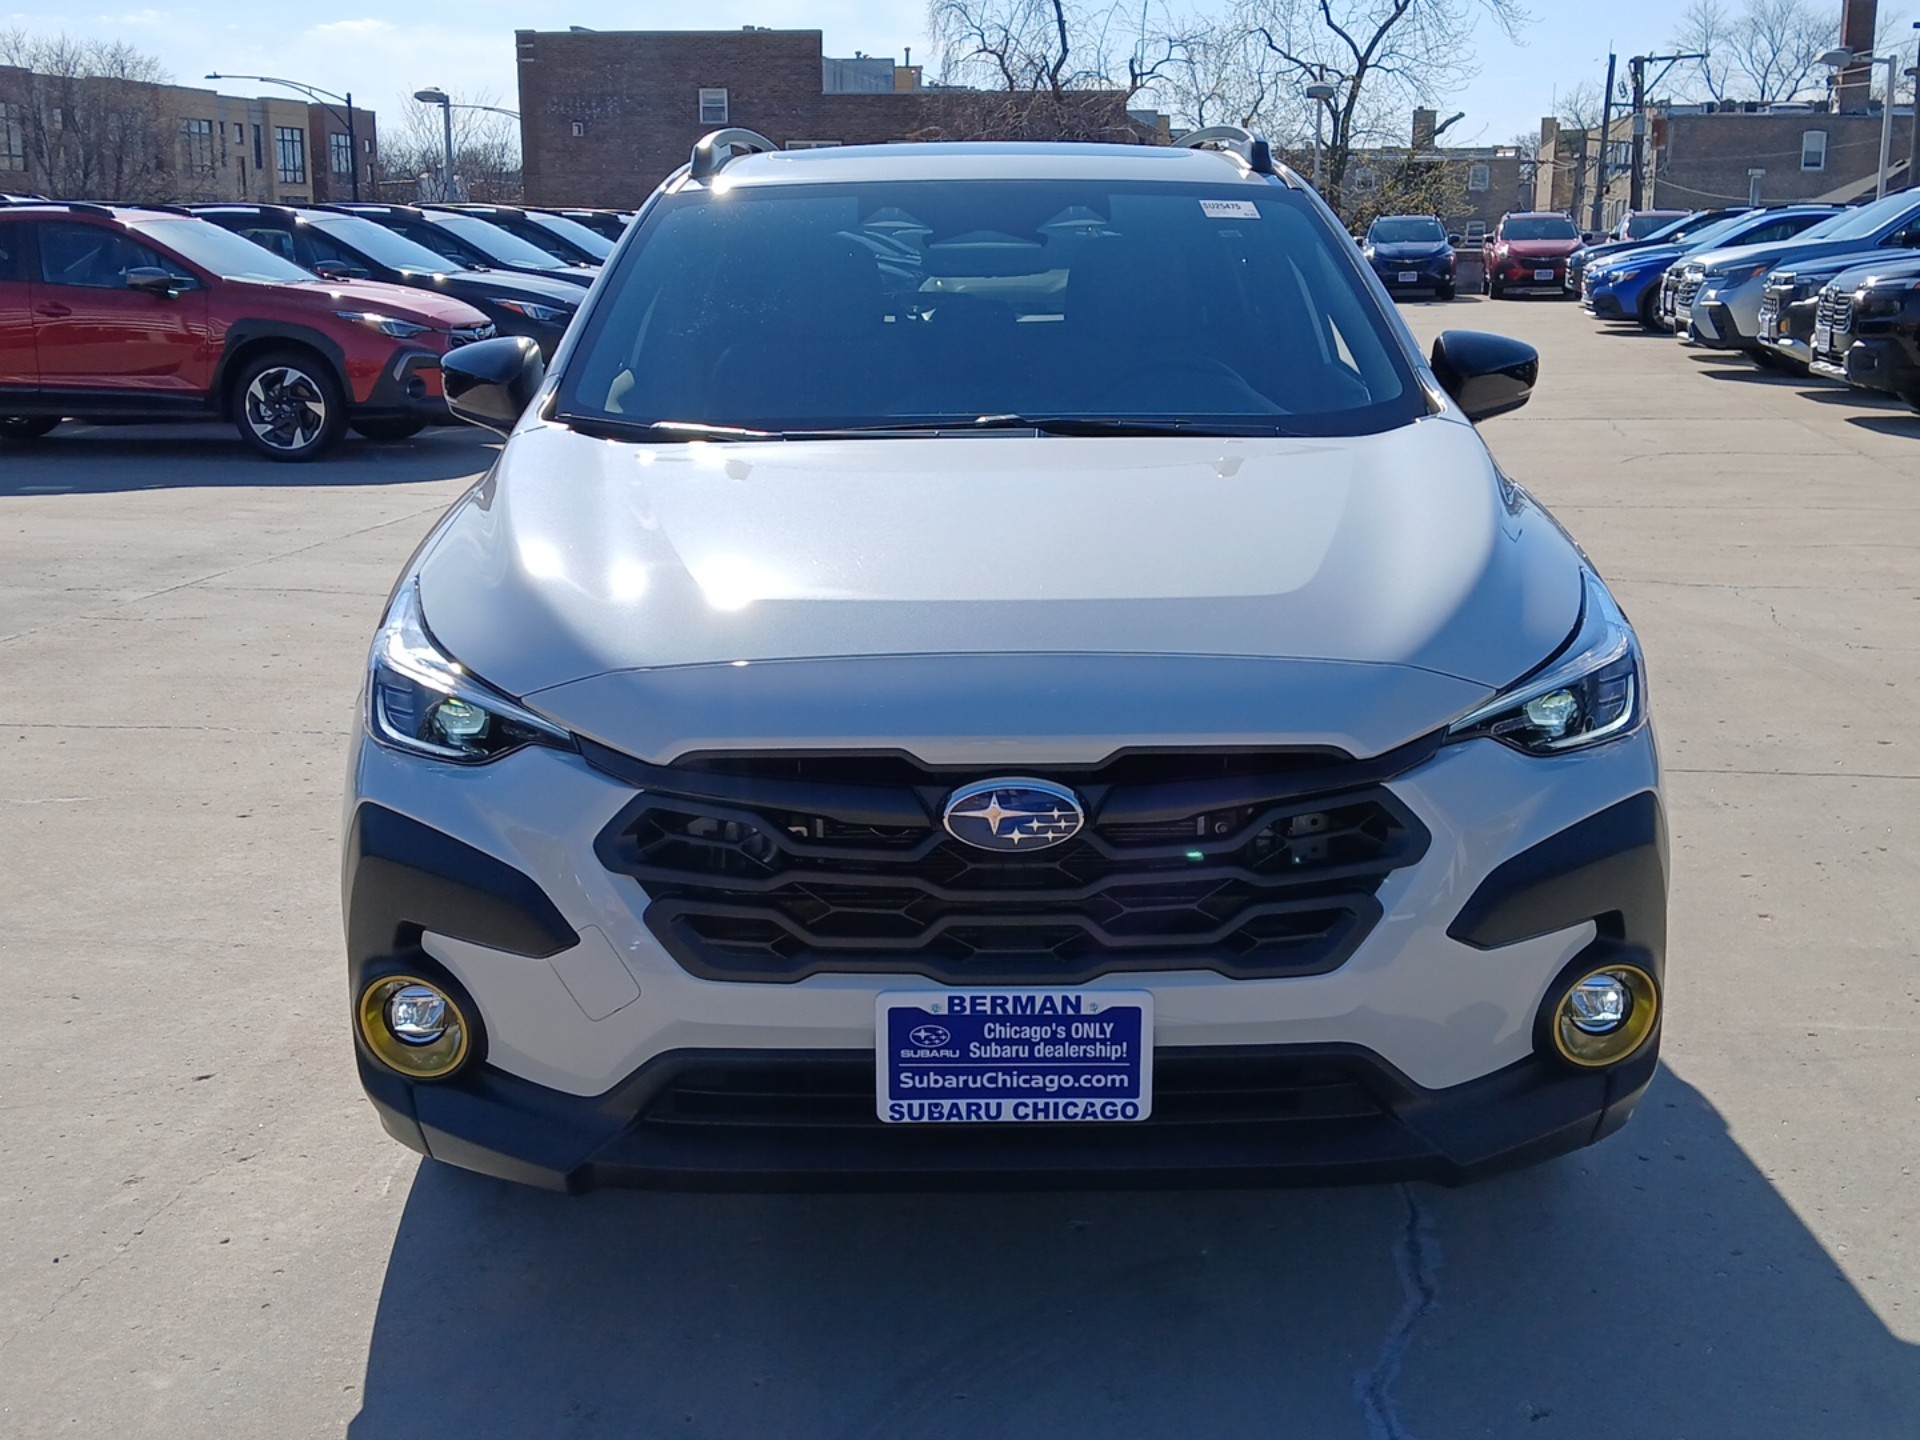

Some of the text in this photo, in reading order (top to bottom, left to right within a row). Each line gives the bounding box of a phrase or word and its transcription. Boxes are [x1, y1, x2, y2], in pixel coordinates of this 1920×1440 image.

[947, 995, 1082, 1015] BERMAN
[983, 1022, 1114, 1042] Chicago's ONLY
[900, 1049, 960, 1058] SUBARU
[969, 1041, 1128, 1061] Subaru dealership!
[899, 1071, 1129, 1092] SubaruChicago.com
[888, 1101, 1140, 1121] SUBARU CHICAGO
